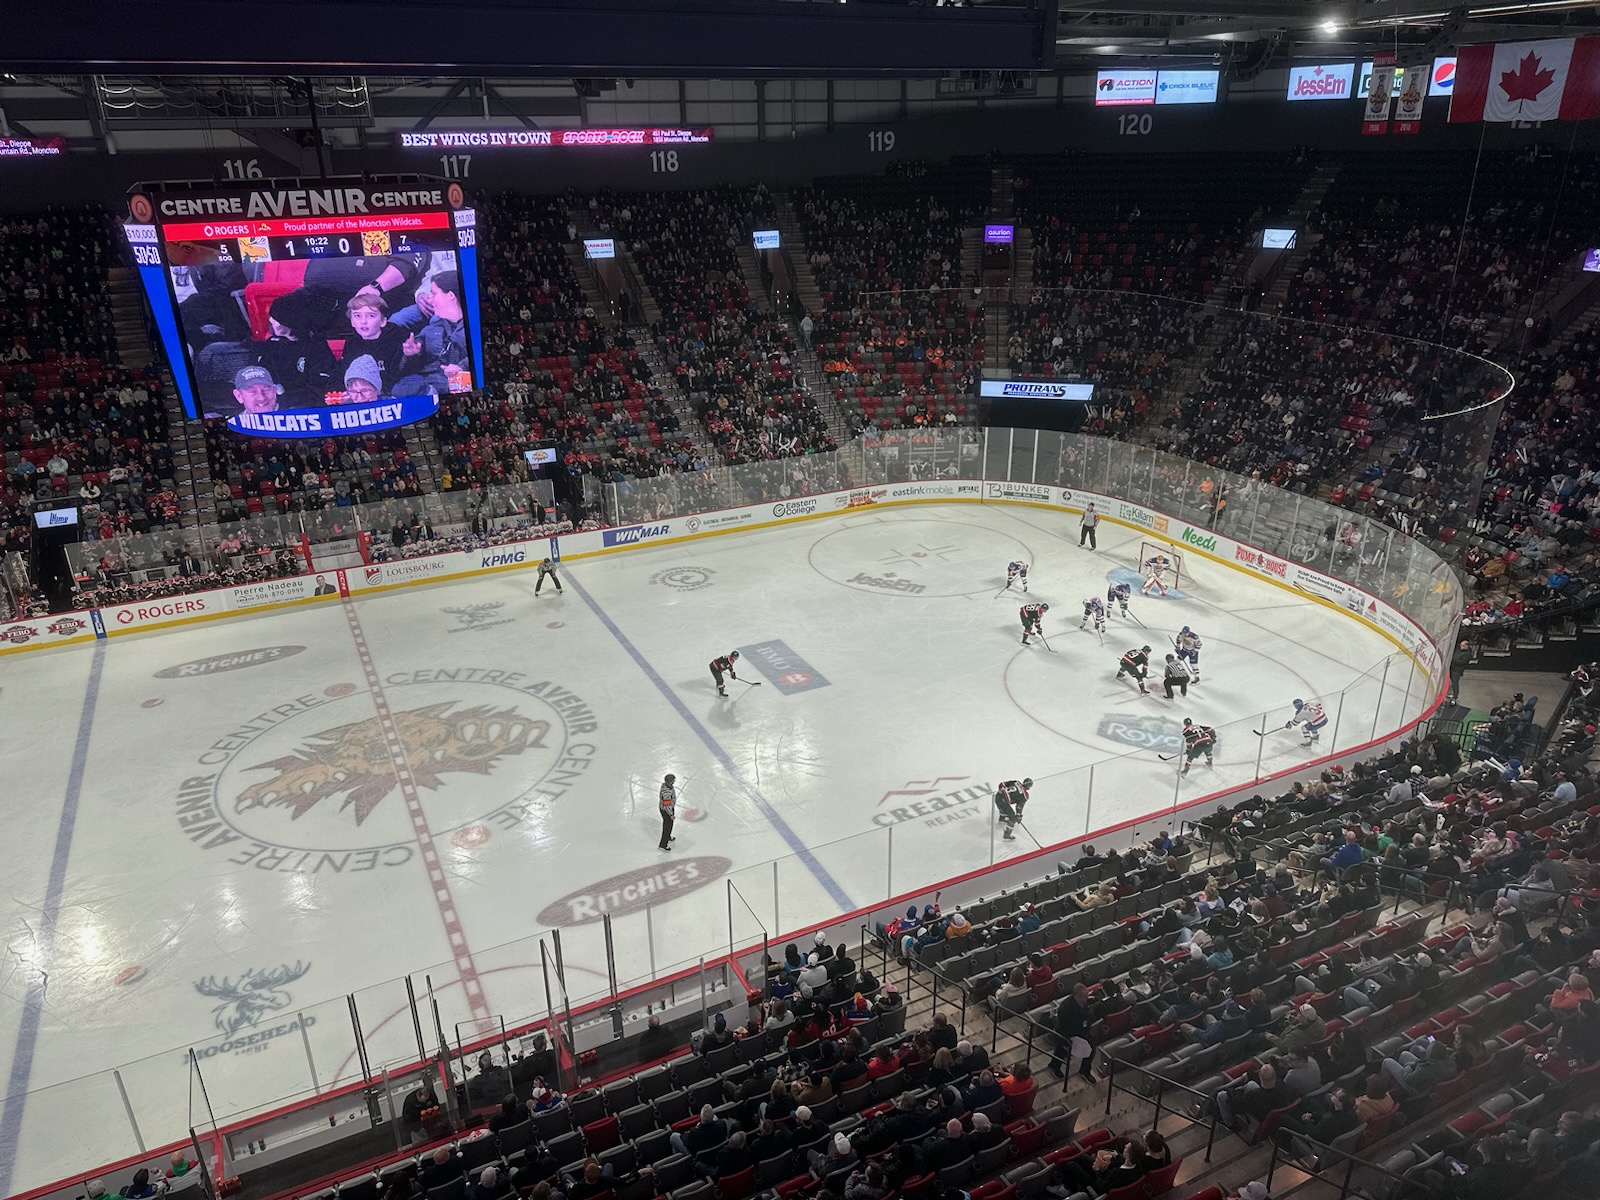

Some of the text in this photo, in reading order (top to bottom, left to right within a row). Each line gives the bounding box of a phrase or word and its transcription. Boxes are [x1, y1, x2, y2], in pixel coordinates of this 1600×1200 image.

[1116, 79, 1154, 87] ACTION
[1294, 74, 1347, 96] JessEm
[1118, 113, 1153, 135] 120
[401, 131, 551, 147] BEST WINGS IN TOWN
[868, 130, 896, 152] 119
[223, 159, 263, 178] 116
[440, 154, 472, 177] 117
[650, 150, 679, 172] 118
[160, 188, 443, 218] CENTRE AVENIR CENTRE
[126, 229, 157, 240] $10,000
[215, 216, 424, 235] ROGERS Proud partner of the Moncton Wildcats.
[304, 236, 329, 246] 10:22
[338, 238, 350, 254] 0
[399, 235, 407, 245] 7
[458, 228, 476, 248] 50/50
[133, 245, 161, 266] 50/50
[220, 244, 228, 254] 5
[285, 240, 296, 257] 1
[311, 246, 325, 254] 1ST
[1004, 383, 1067, 398] PROTRANS
[239, 403, 403, 431] WILDCATS HOCKEY
[892, 486, 925, 497] eastlink
[925, 485, 954, 495] mobile
[1006, 483, 1050, 495] BUNKER
[786, 499, 817, 509] Eastern
[786, 505, 816, 515] College
[1132, 506, 1154, 522] Killam
[615, 524, 670, 542] WINMAR
[1182, 526, 1217, 551] Needs
[481, 550, 525, 568] KPMG
[1234, 544, 1257, 564] PUMP
[1265, 558, 1288, 578] HOUSE
[386, 561, 445, 577] LOUISBOURG
[234, 580, 303, 597] Pierre Nadeau
[337, 571, 347, 591] CCM
[847, 571, 927, 595] JessEm
[1317, 576, 1331, 585] Proud
[255, 586, 305, 600] 506-870-0999
[138, 598, 205, 621] ROGERS
[7, 629, 31, 638] FERO
[55, 621, 79, 630] FERO
[177, 648, 281, 677] RITCHIE'S
[756, 646, 791, 671] BMO
[385, 667, 599, 738] CENTRE AVENIR
[198, 693, 318, 767] CENTRE
[1106, 722, 1182, 748] Roya
[176, 774, 243, 851] AVENIR
[924, 805, 982, 829] REALTY
[228, 844, 415, 874] CENTRE
[566, 862, 700, 922] RITCHIE'S
[182, 1015, 317, 1065] MOOSEHEAD
